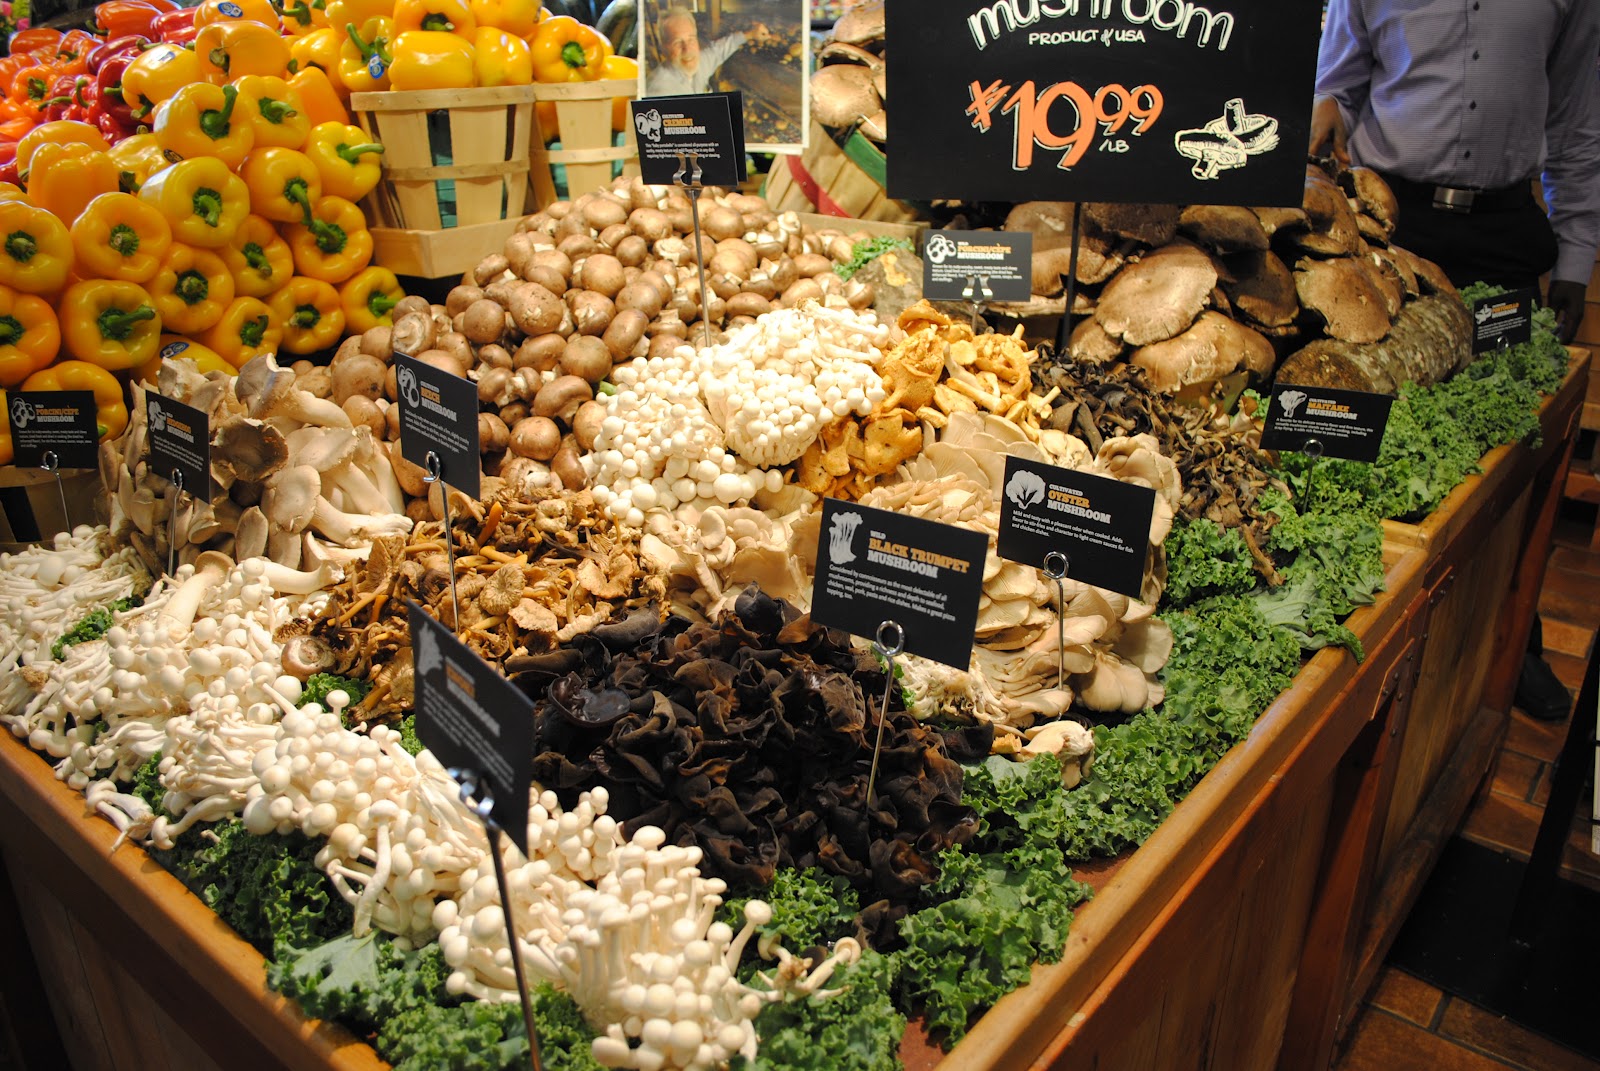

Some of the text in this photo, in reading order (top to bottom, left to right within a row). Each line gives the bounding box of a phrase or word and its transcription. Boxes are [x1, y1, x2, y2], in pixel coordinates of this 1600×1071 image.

[1028, 29, 1100, 46] PRODUCT
[1114, 29, 1147, 43] USA
[663, 118, 693, 127] CREMINI
[664, 126, 706, 135] MUSHROOM
[1099, 138, 1130, 153] /LB
[957, 252, 1004, 260] MUSHROOM
[421, 397, 457, 422] MUSHROOM
[1306, 408, 1358, 420] MUSHROOM
[1308, 402, 1350, 413] MAITAKE
[1049, 484, 1083, 496] CULTIVATED
[1048, 490, 1090, 508] OYSTER
[1047, 499, 1111, 524] MUSHROOM
[870, 530, 886, 540] WILD
[1012, 515, 1025, 525] flavor
[1024, 519, 1029, 527] to
[1054, 527, 1074, 536] character
[1078, 533, 1089, 541] light
[1103, 541, 1117, 549] sauces
[1020, 524, 1036, 532] chicken
[1035, 528, 1049, 536] dishes.
[1030, 515, 1042, 523] tasty
[1053, 521, 1072, 530] pleasant
[1094, 532, 1111, 540] cooked.
[1111, 536, 1123, 544] Adds
[868, 538, 970, 573] BLACK TRUMPET
[867, 550, 938, 579] MUSHROOM
[828, 573, 855, 585] mushrooms,
[854, 580, 876, 591] providing
[906, 593, 920, 602] depth
[829, 564, 853, 575] Considered
[852, 570, 859, 578] by
[900, 584, 913, 592] most
[934, 593, 942, 601] of
[826, 587, 844, 598] topping,
[827, 579, 844, 590] chicken,
[854, 588, 866, 596] pork,
[865, 590, 879, 599] pasta
[895, 598, 911, 608] dishes.
[911, 603, 927, 613] Makes
